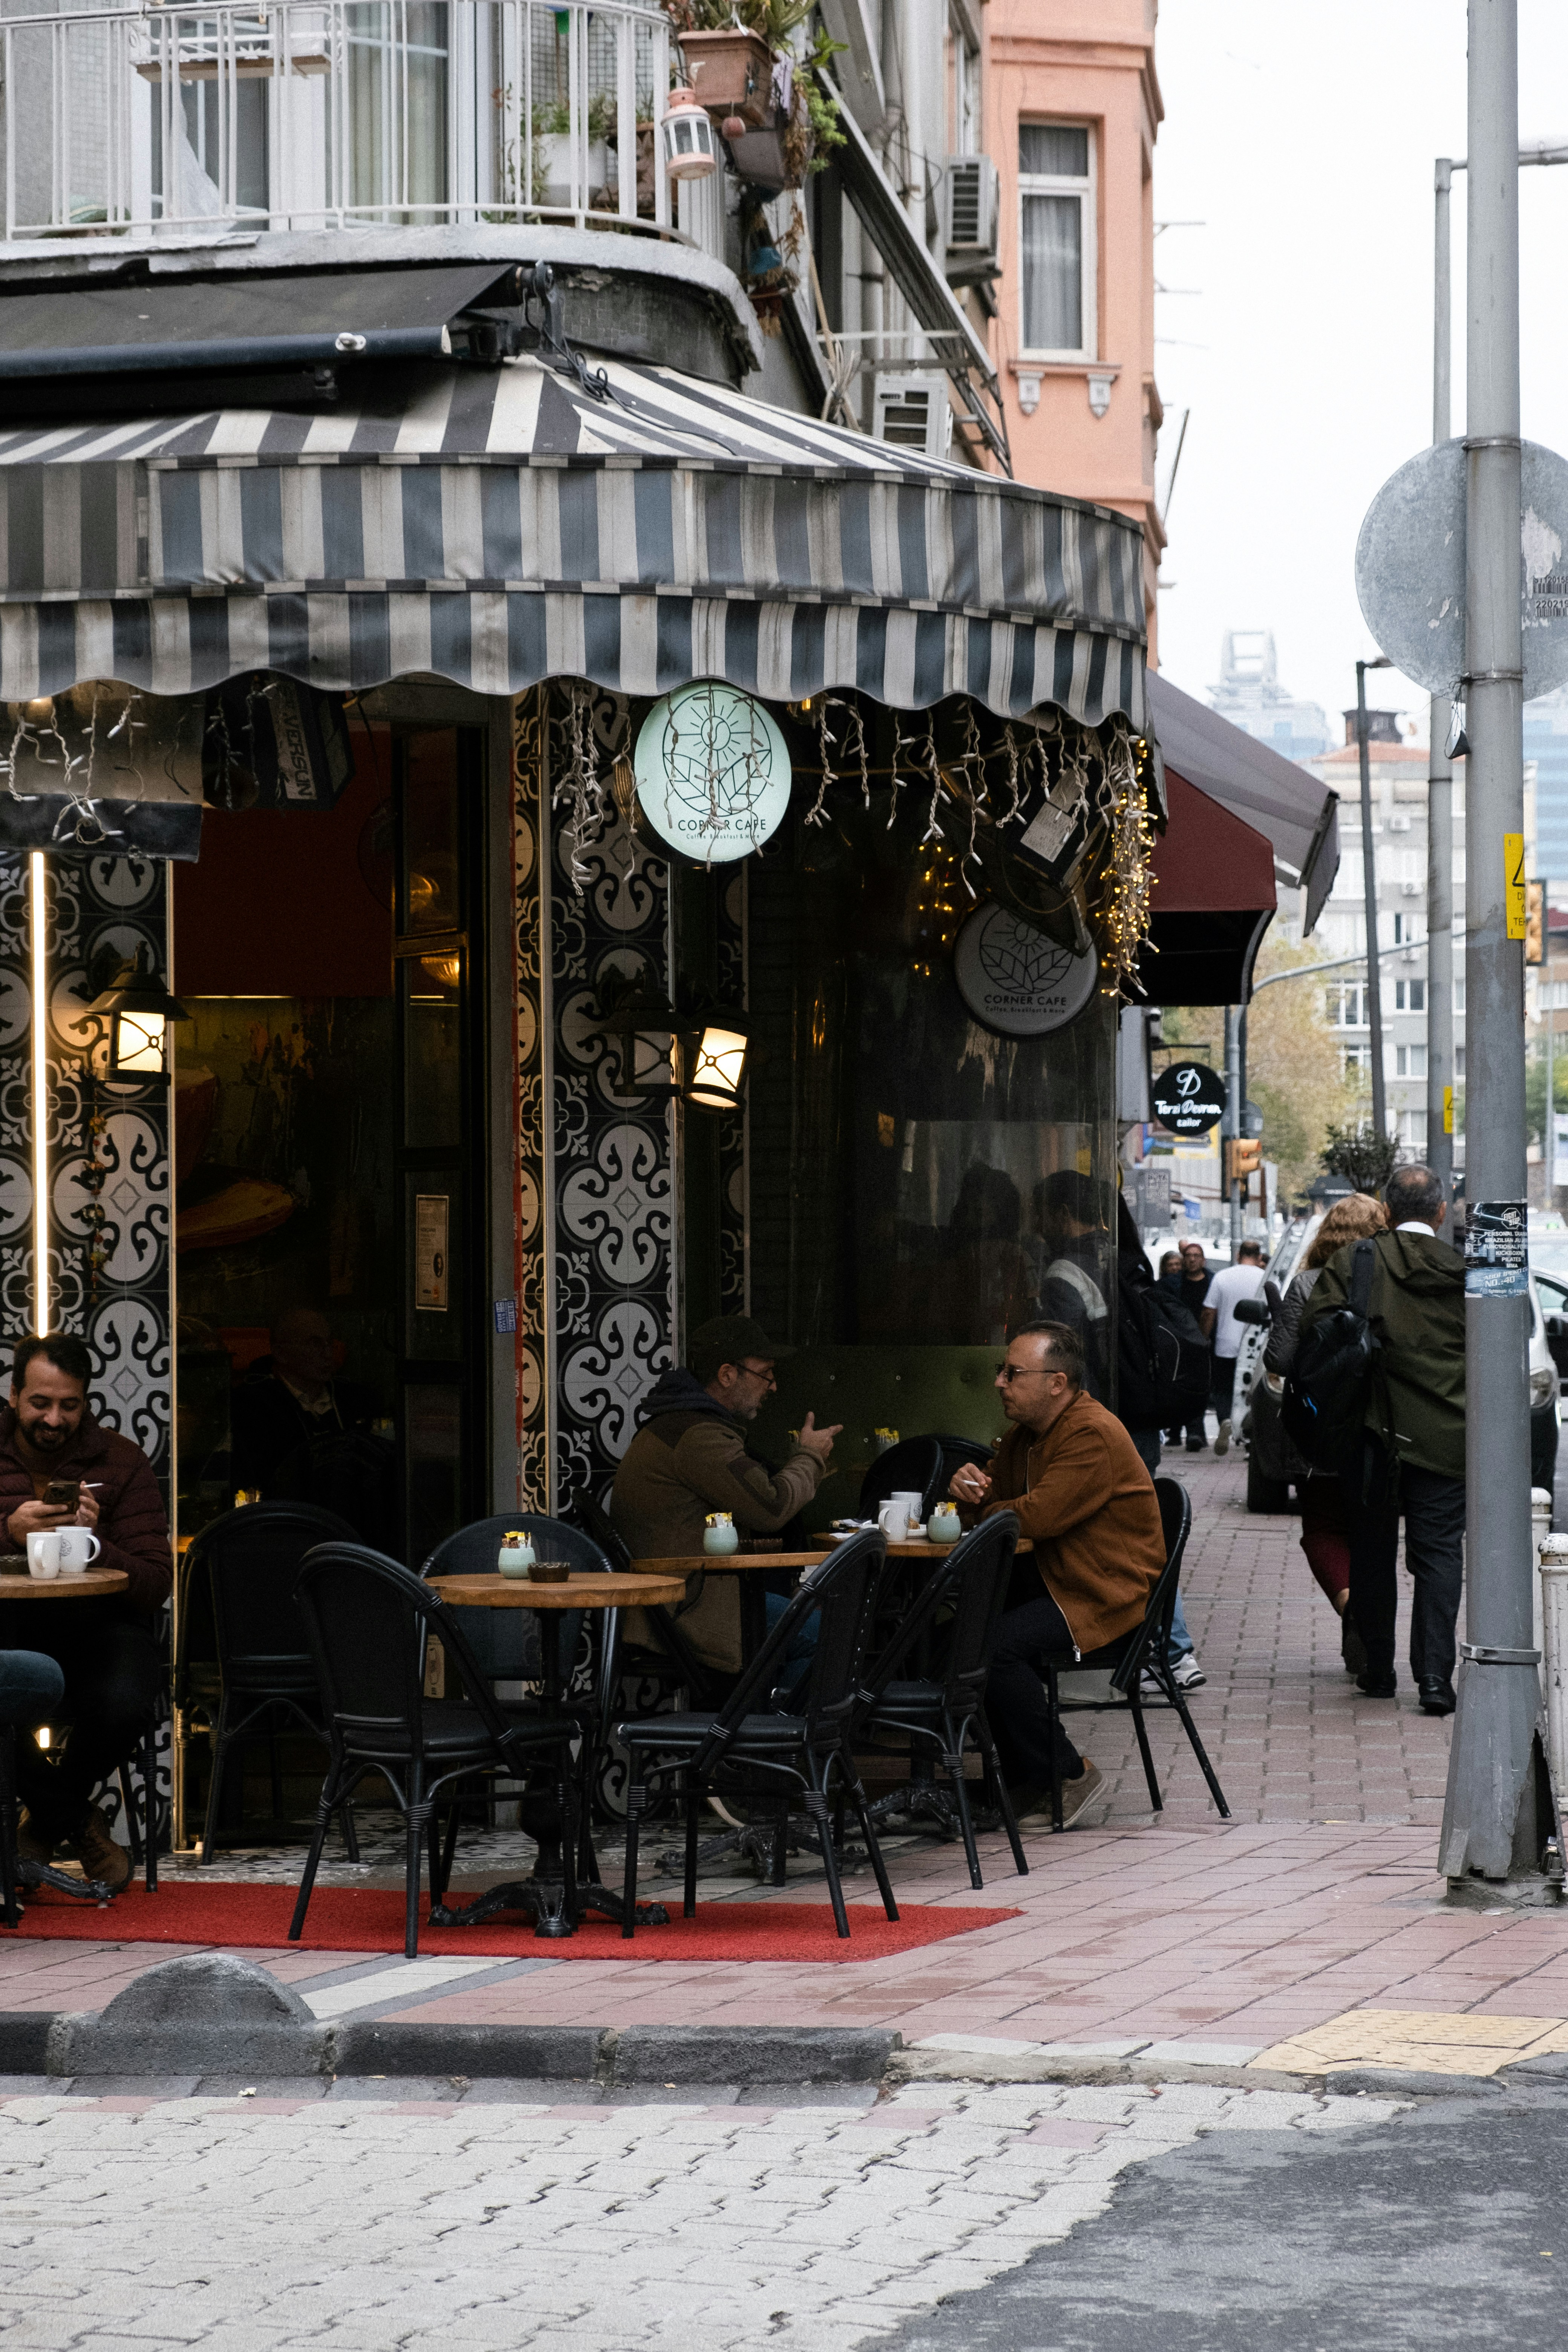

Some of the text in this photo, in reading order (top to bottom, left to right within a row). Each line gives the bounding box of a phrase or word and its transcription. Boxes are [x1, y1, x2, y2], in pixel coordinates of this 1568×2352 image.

[678, 819, 766, 830] CORNR CAFE
[985, 995, 1067, 1006] CORNER CAFE
[1155, 1099, 1222, 1114] Terzi Devran
[1176, 1117, 1202, 1127] tailor
